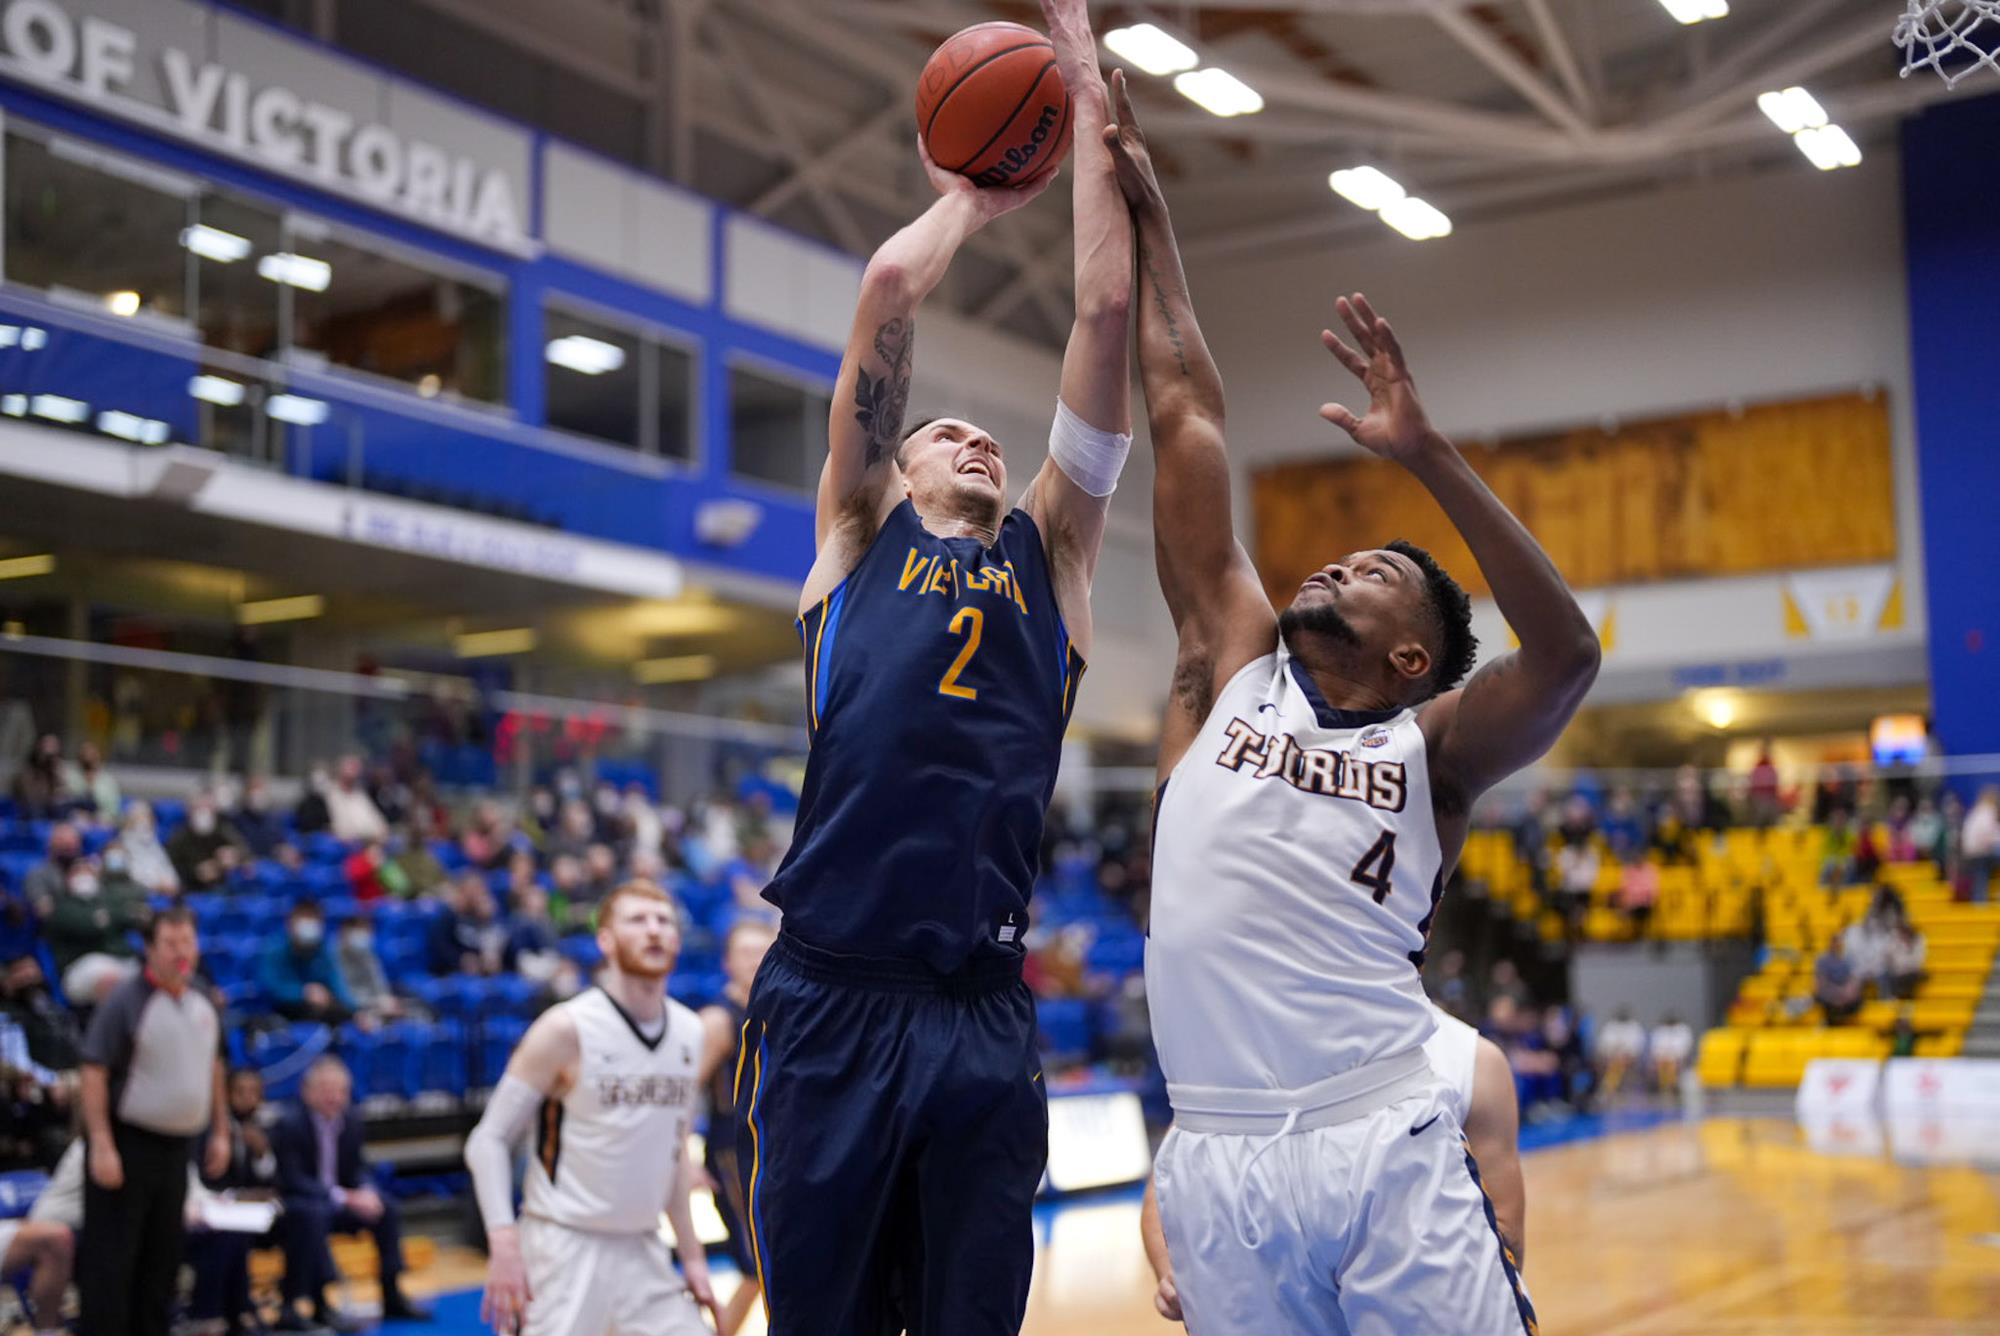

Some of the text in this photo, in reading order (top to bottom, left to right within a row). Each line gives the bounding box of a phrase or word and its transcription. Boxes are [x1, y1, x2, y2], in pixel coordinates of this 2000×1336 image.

[2, 0, 524, 243] OF VICTORIA
[937, 606, 985, 701] 2
[1350, 828, 1398, 906] 4
